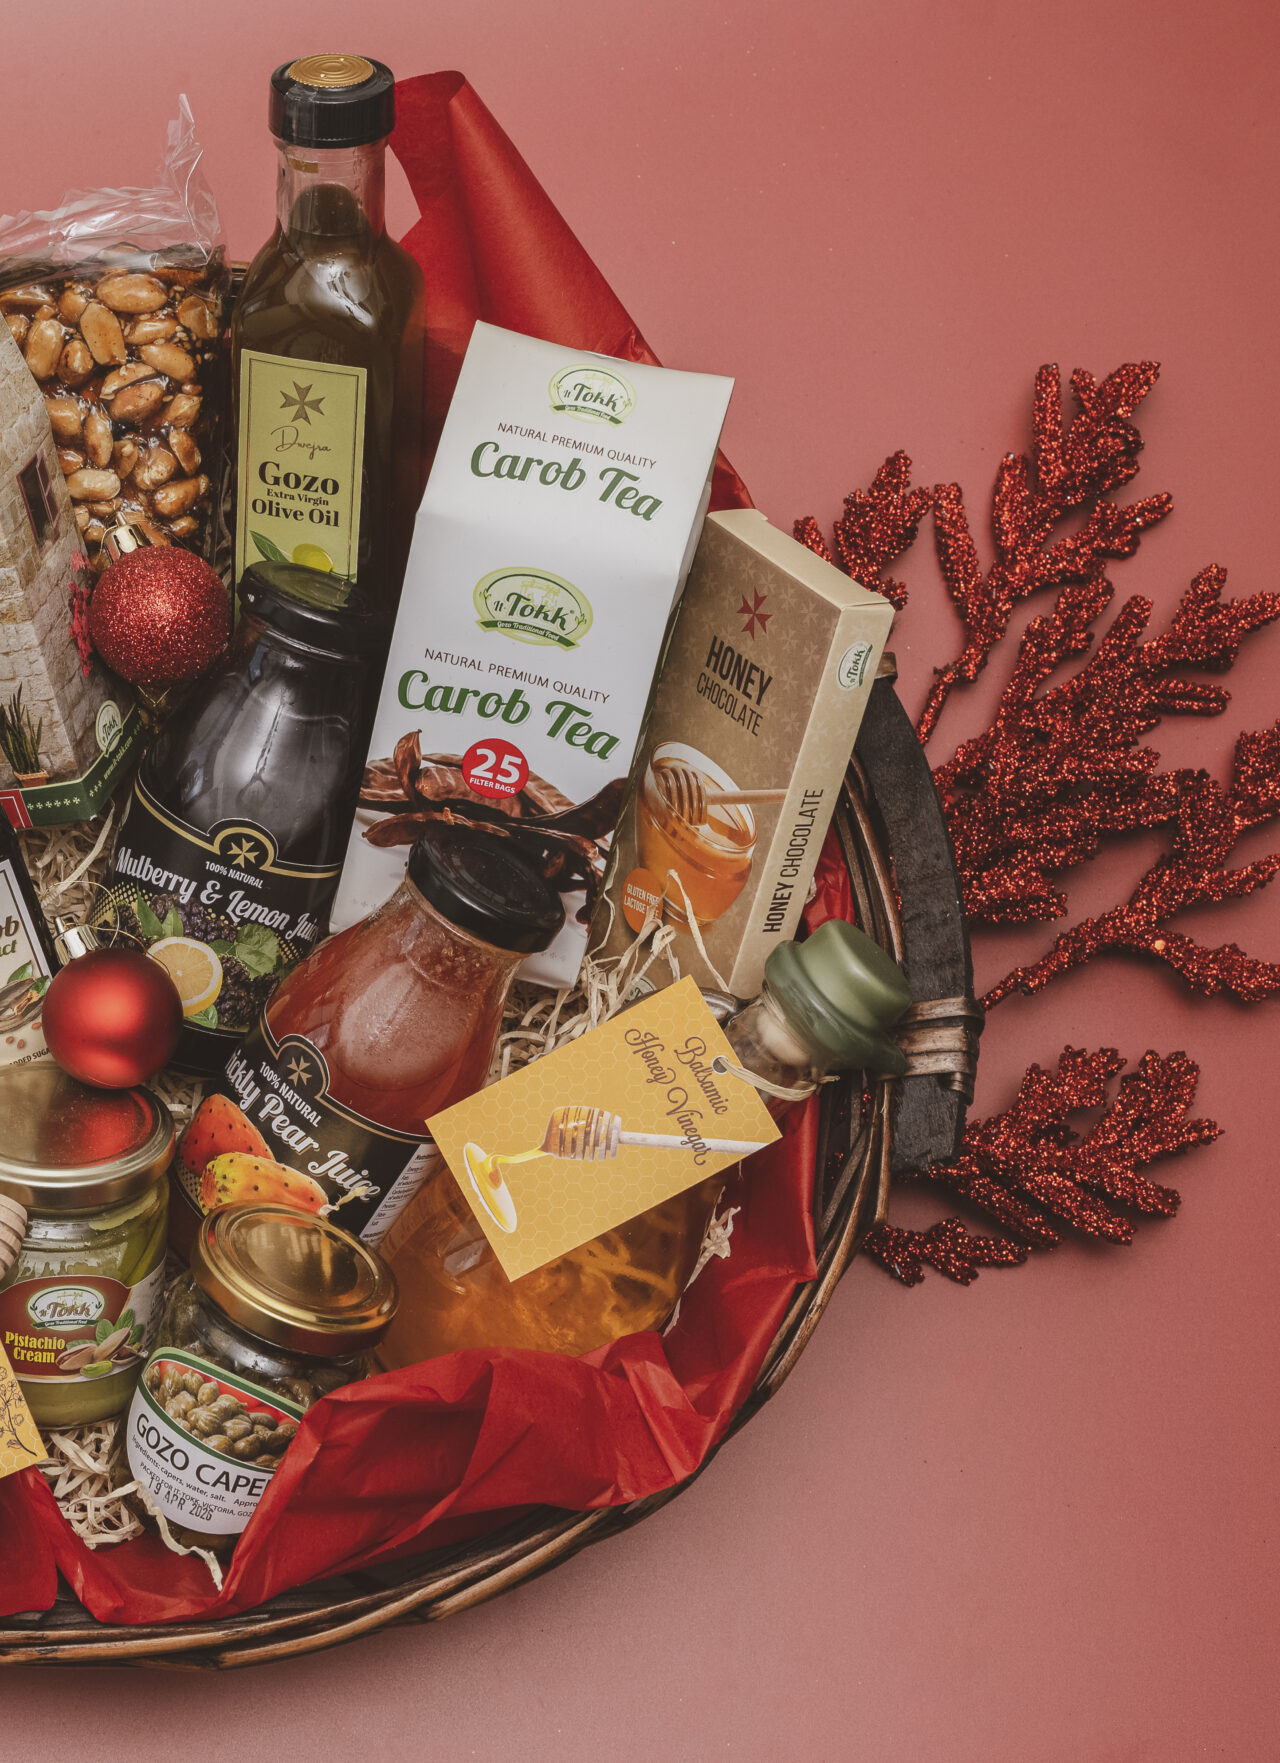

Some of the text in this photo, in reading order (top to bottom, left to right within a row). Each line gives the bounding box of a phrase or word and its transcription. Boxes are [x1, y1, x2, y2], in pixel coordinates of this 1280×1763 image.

[497, 422, 656, 471] NATURAL PREMIUM QUALITY
[258, 461, 340, 496] Gozo
[266, 488, 329, 507] Extra Virgin
[470, 441, 663, 521] Carob Tea
[252, 498, 340, 528] Olive Oil
[424, 648, 610, 704] NATURAL PREMIUM QUALITY
[705, 636, 773, 706] HONEY
[397, 669, 621, 761] Carob Tea
[697, 672, 763, 737] CHOCOLATE
[469, 747, 521, 784] 25
[469, 777, 515, 793] FILTER BAGS
[205, 860, 264, 889] 100% NATURAL
[763, 788, 824, 933] HONEY CHOCOLATE
[116, 846, 320, 942] Mulberry & Lemon Juic
[624, 895, 646, 914] LACTOSE
[626, 884, 646, 901] GLUTEN
[259, 1062, 322, 1128] 100% NATURAL
[624, 1028, 712, 1166] Honey Vinegar
[674, 1036, 728, 1116] Balsamic
[224, 1049, 260, 1110] ickly
[258, 1093, 320, 1152] Pear
[308, 1150, 380, 1200] Juice
[5, 1331, 65, 1350] Pistachio
[13, 1347, 55, 1363] Cream
[132, 1436, 258, 1508] Ingredients: capers, water, salt. Appro
[136, 1414, 273, 1497] GOZO CAPE
[140, 1462, 161, 1484] PACKED
[161, 1480, 174, 1493] FOR
[202, 1502, 234, 1516] VICTORIA,
[237, 1509, 253, 1517] GOZ
[148, 1477, 214, 1521] 19 APR 2026
